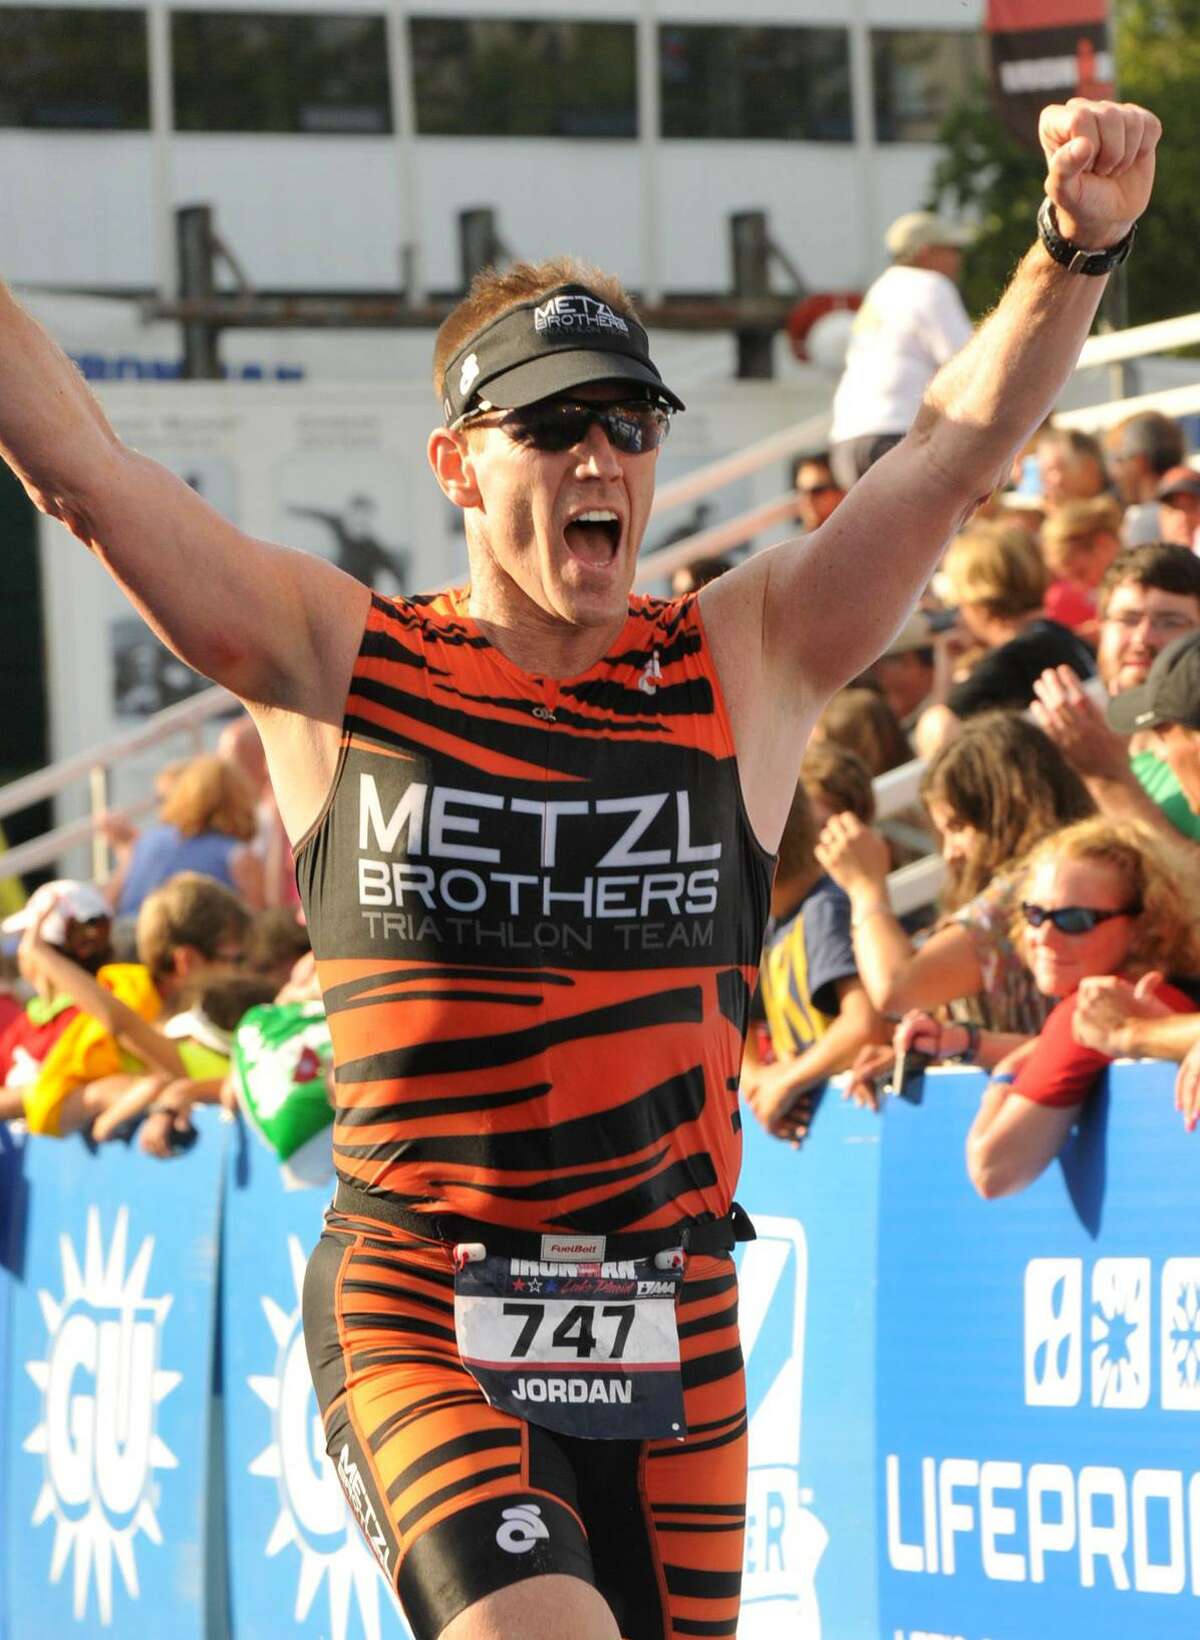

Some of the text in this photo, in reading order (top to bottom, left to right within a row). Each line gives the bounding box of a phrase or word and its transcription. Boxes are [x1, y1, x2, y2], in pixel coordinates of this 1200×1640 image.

[535, 313, 629, 332] BROTHERS
[358, 773, 722, 867] METZL
[358, 859, 720, 919] BROTHERS
[361, 911, 714, 951] TRIATHLON TEAM
[503, 1303, 636, 1359] 747
[46, 1313, 157, 1515] GU
[511, 1378, 633, 1404] JORDAN
[886, 1454, 1200, 1596] LIFEPRO
